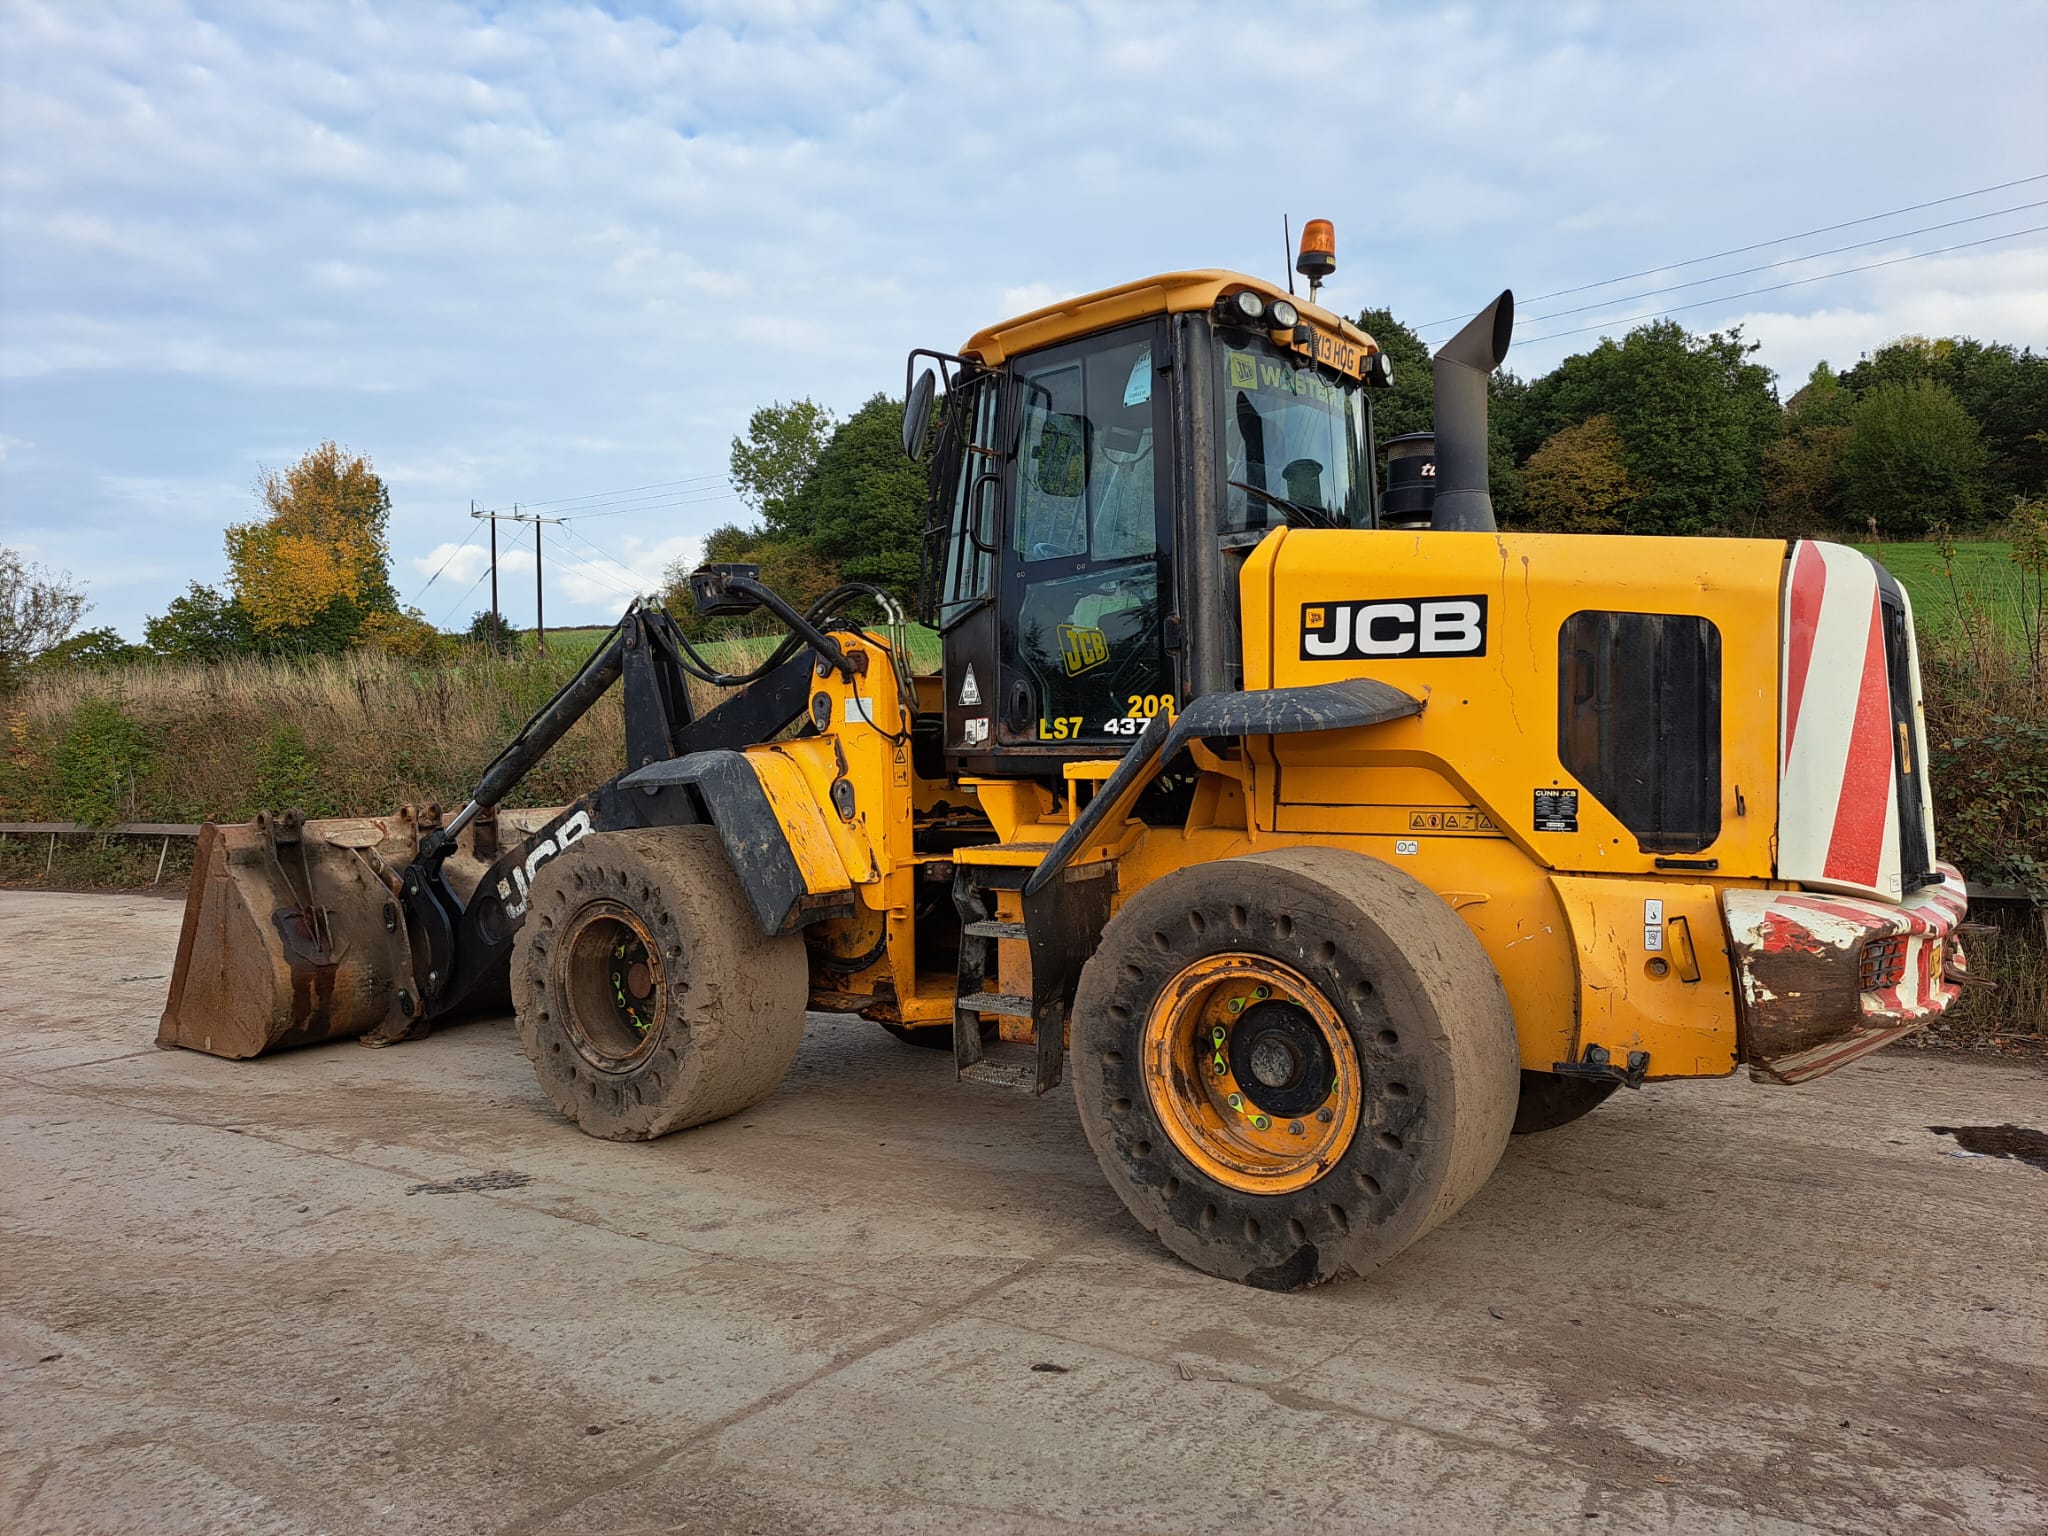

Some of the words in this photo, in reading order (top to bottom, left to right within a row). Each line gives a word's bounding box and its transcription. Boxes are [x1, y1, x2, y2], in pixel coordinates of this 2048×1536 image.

[1333, 341, 1355, 371] HOG
[1304, 600, 1482, 656] JCB
[1066, 630, 1106, 671] JCB
[1127, 694, 1175, 719] 208
[1039, 716, 1083, 740] LS7
